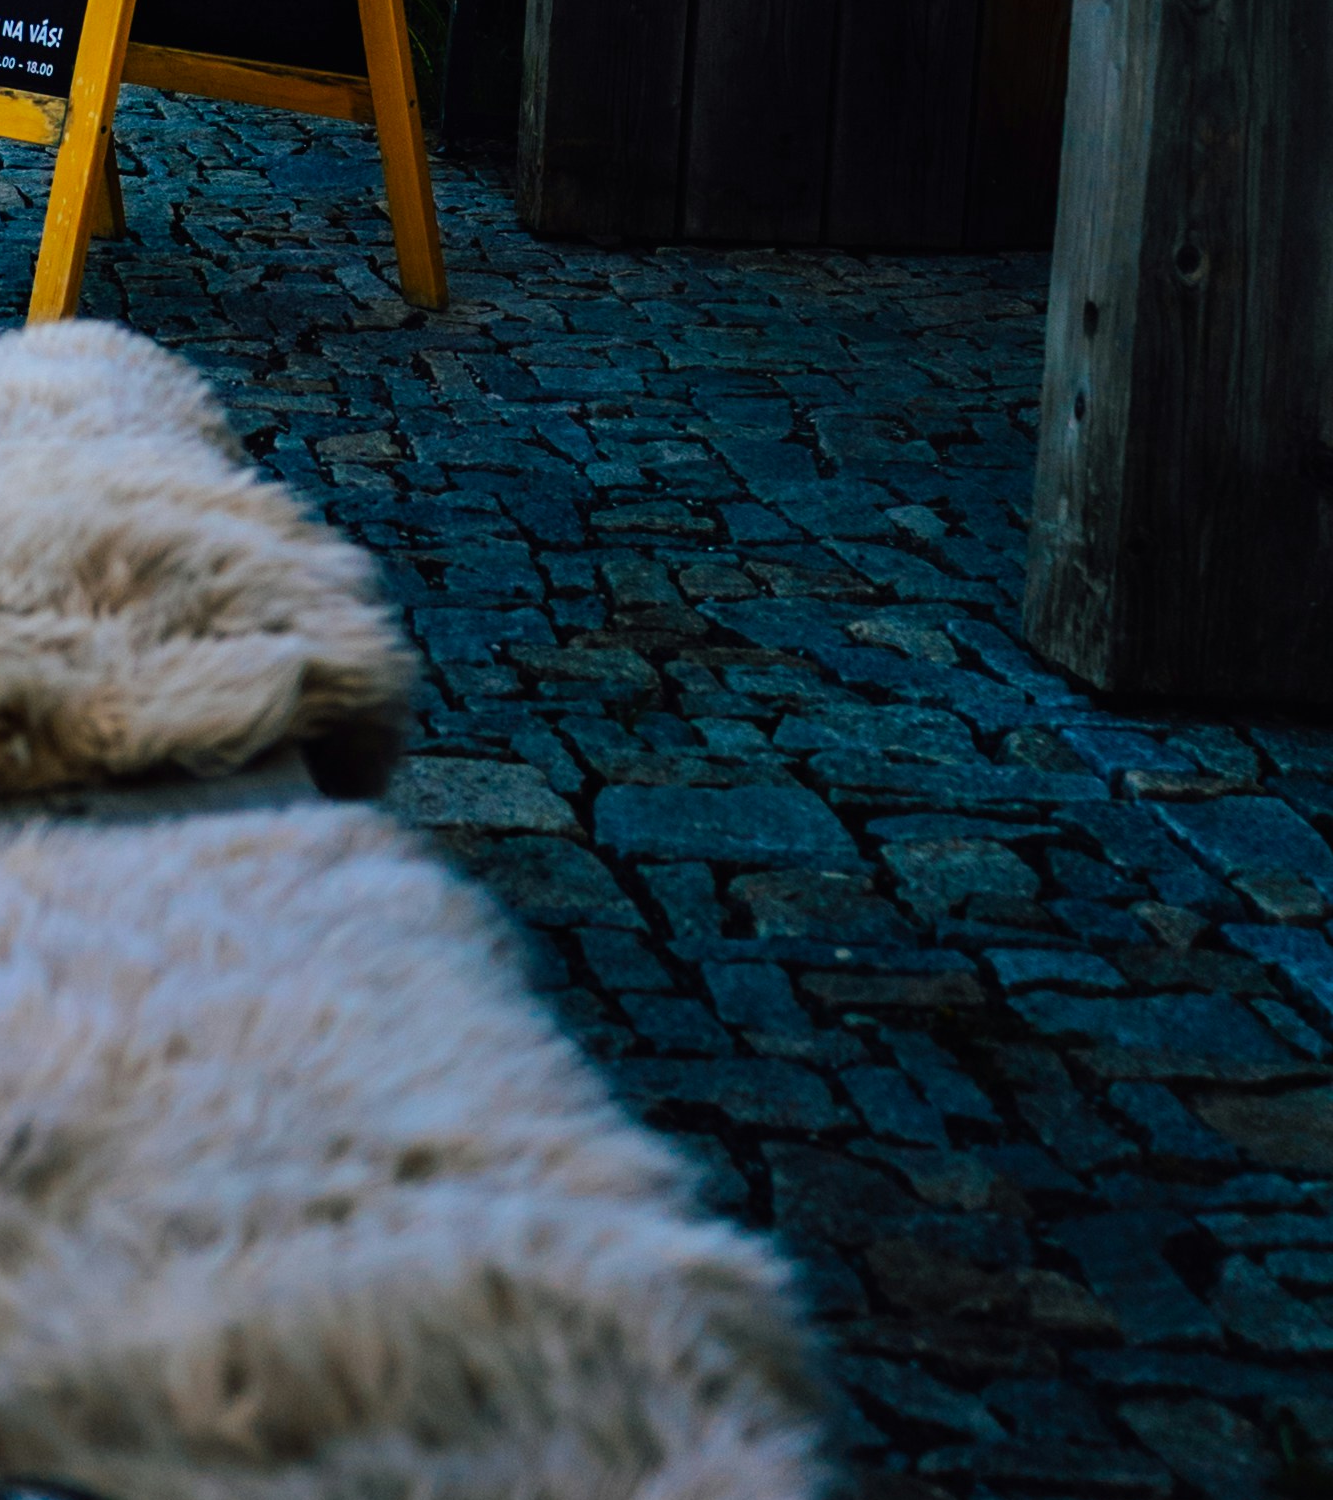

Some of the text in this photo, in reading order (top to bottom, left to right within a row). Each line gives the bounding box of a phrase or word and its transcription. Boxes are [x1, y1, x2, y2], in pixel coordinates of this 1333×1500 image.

[2, 20, 24, 42] NA
[29, 18, 64, 48] VÁS!
[26, 60, 54, 77] 18.00
